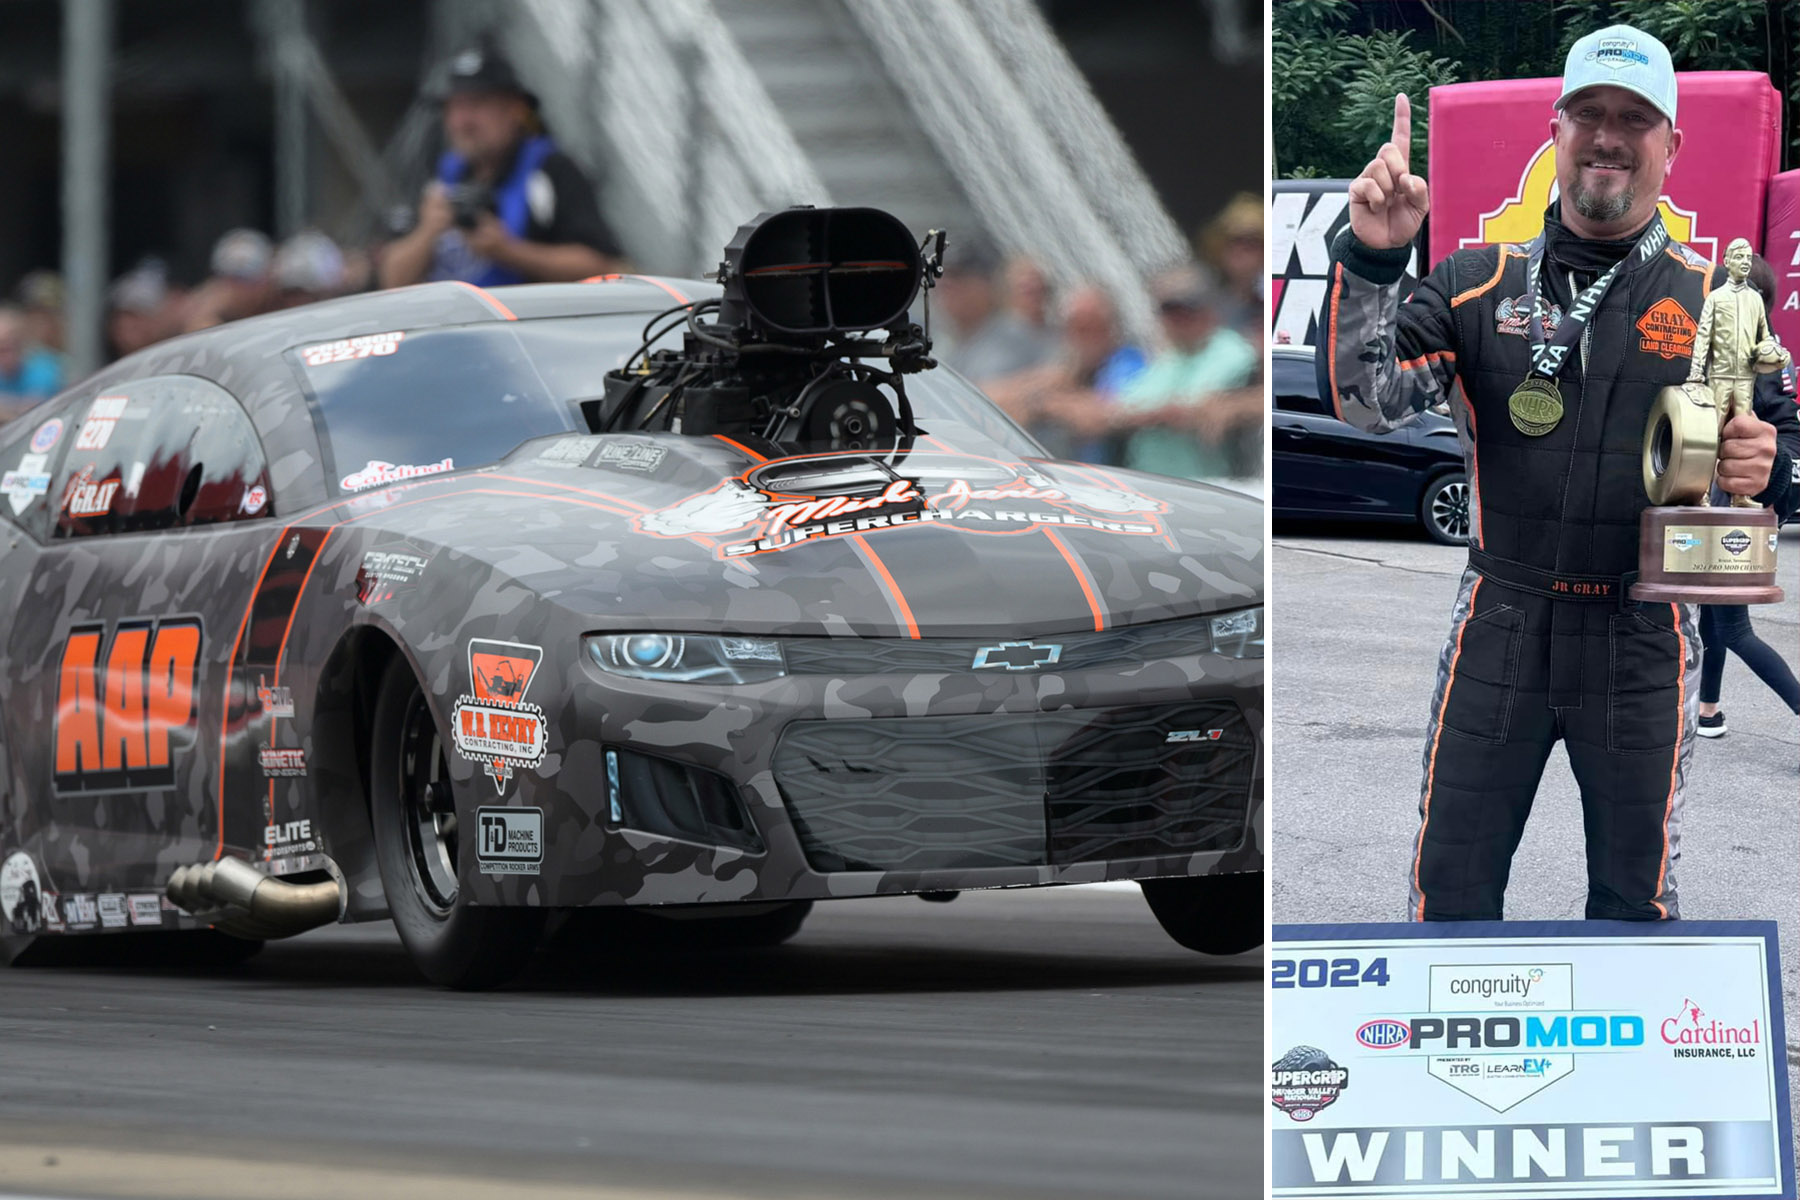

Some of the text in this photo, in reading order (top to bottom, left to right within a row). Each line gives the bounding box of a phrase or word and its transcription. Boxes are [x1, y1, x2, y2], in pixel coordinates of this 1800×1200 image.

[1651, 311, 1686, 327] GRAY
[1645, 323, 1692, 337] CONTRACTING
[342, 459, 454, 490] Cardinal
[69, 480, 120, 516] GRAY
[724, 509, 1155, 557] SUPERCHARGERS
[1552, 580, 1611, 595] JR GRAY
[55, 625, 200, 773] AAP
[488, 713, 537, 745] HENRY
[1164, 729, 1224, 743] ZL1
[261, 749, 306, 769] KINETIC
[519, 744, 533, 754] INC
[264, 819, 311, 845] ELITE
[508, 830, 534, 841] MACHINE
[508, 841, 539, 853] PRODUCTS
[1272, 957, 1390, 989] 2024
[1450, 973, 1531, 998] congruity
[1361, 1024, 1405, 1045] NHRA
[1660, 1018, 1760, 1044] Cardinal
[1673, 1048, 1755, 1059] INSURANCE, LLC
[1272, 1069, 1347, 1086] UPERGRIP
[1307, 1086, 1338, 1095] VALLEY
[1301, 1125, 1706, 1183] WINNER
